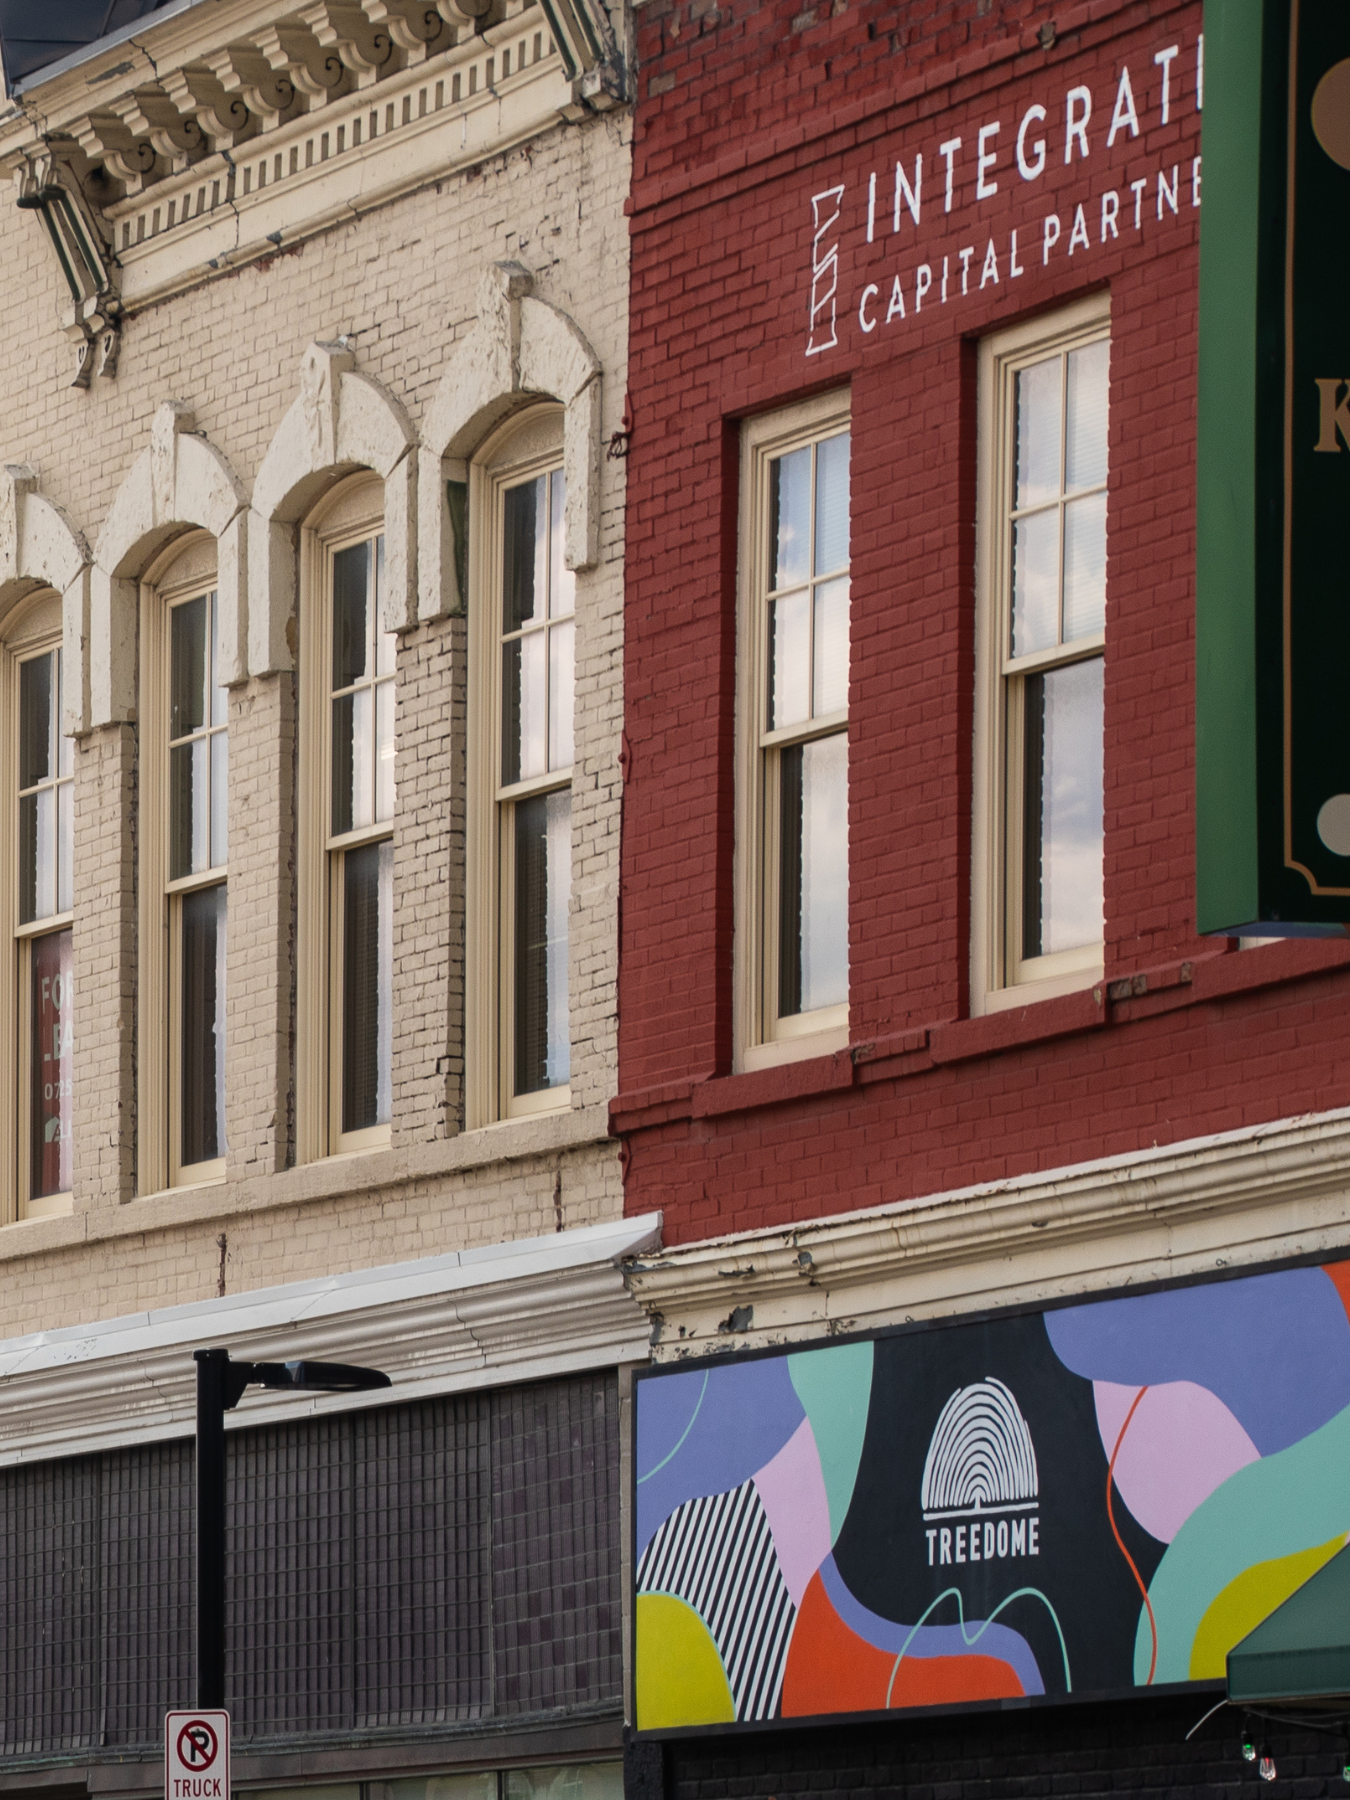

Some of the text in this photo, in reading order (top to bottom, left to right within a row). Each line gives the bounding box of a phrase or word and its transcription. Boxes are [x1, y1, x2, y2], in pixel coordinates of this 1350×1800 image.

[858, 229, 1024, 333] CAPITAL
[925, 1517, 1040, 1566] TREEDOME
[173, 1778, 222, 1798] TRUCK
